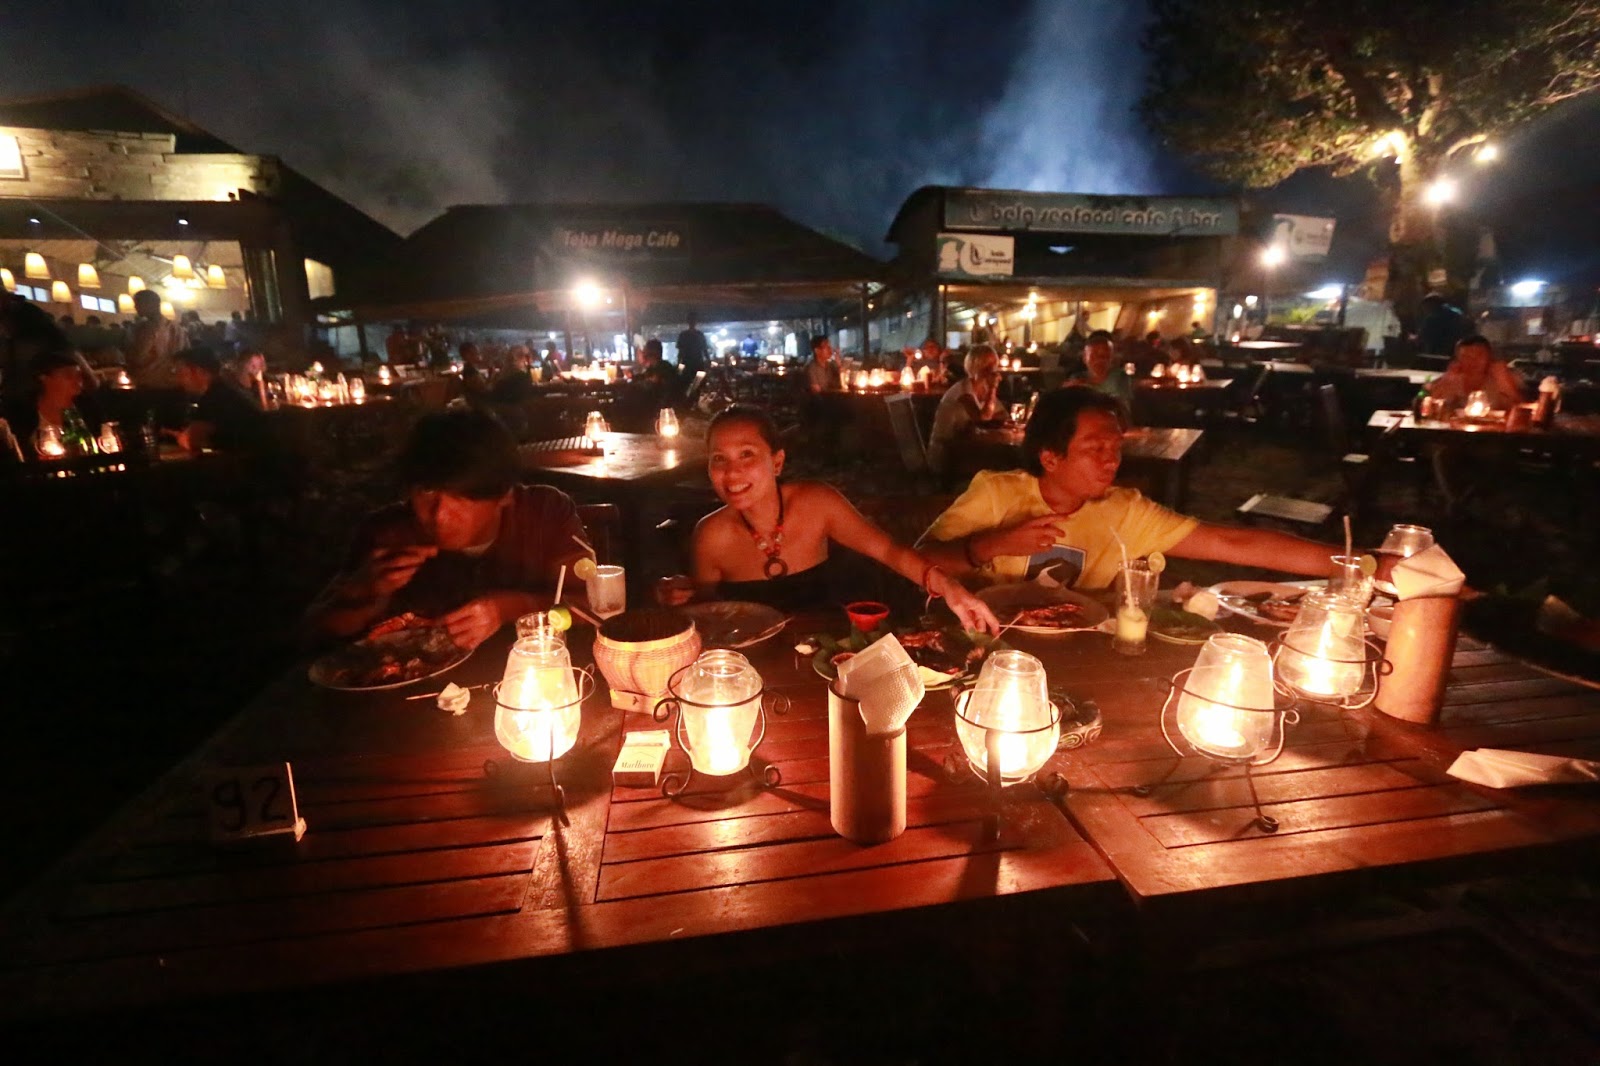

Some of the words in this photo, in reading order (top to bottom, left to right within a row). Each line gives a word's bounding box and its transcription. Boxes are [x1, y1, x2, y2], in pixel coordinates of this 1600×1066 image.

[1040, 204, 1117, 224] seafood
[1122, 207, 1166, 225] cafe
[1189, 208, 1222, 226] bar
[647, 230, 681, 247] Cafe
[621, 759, 655, 770] Marlboro
[214, 775, 287, 831] 92
